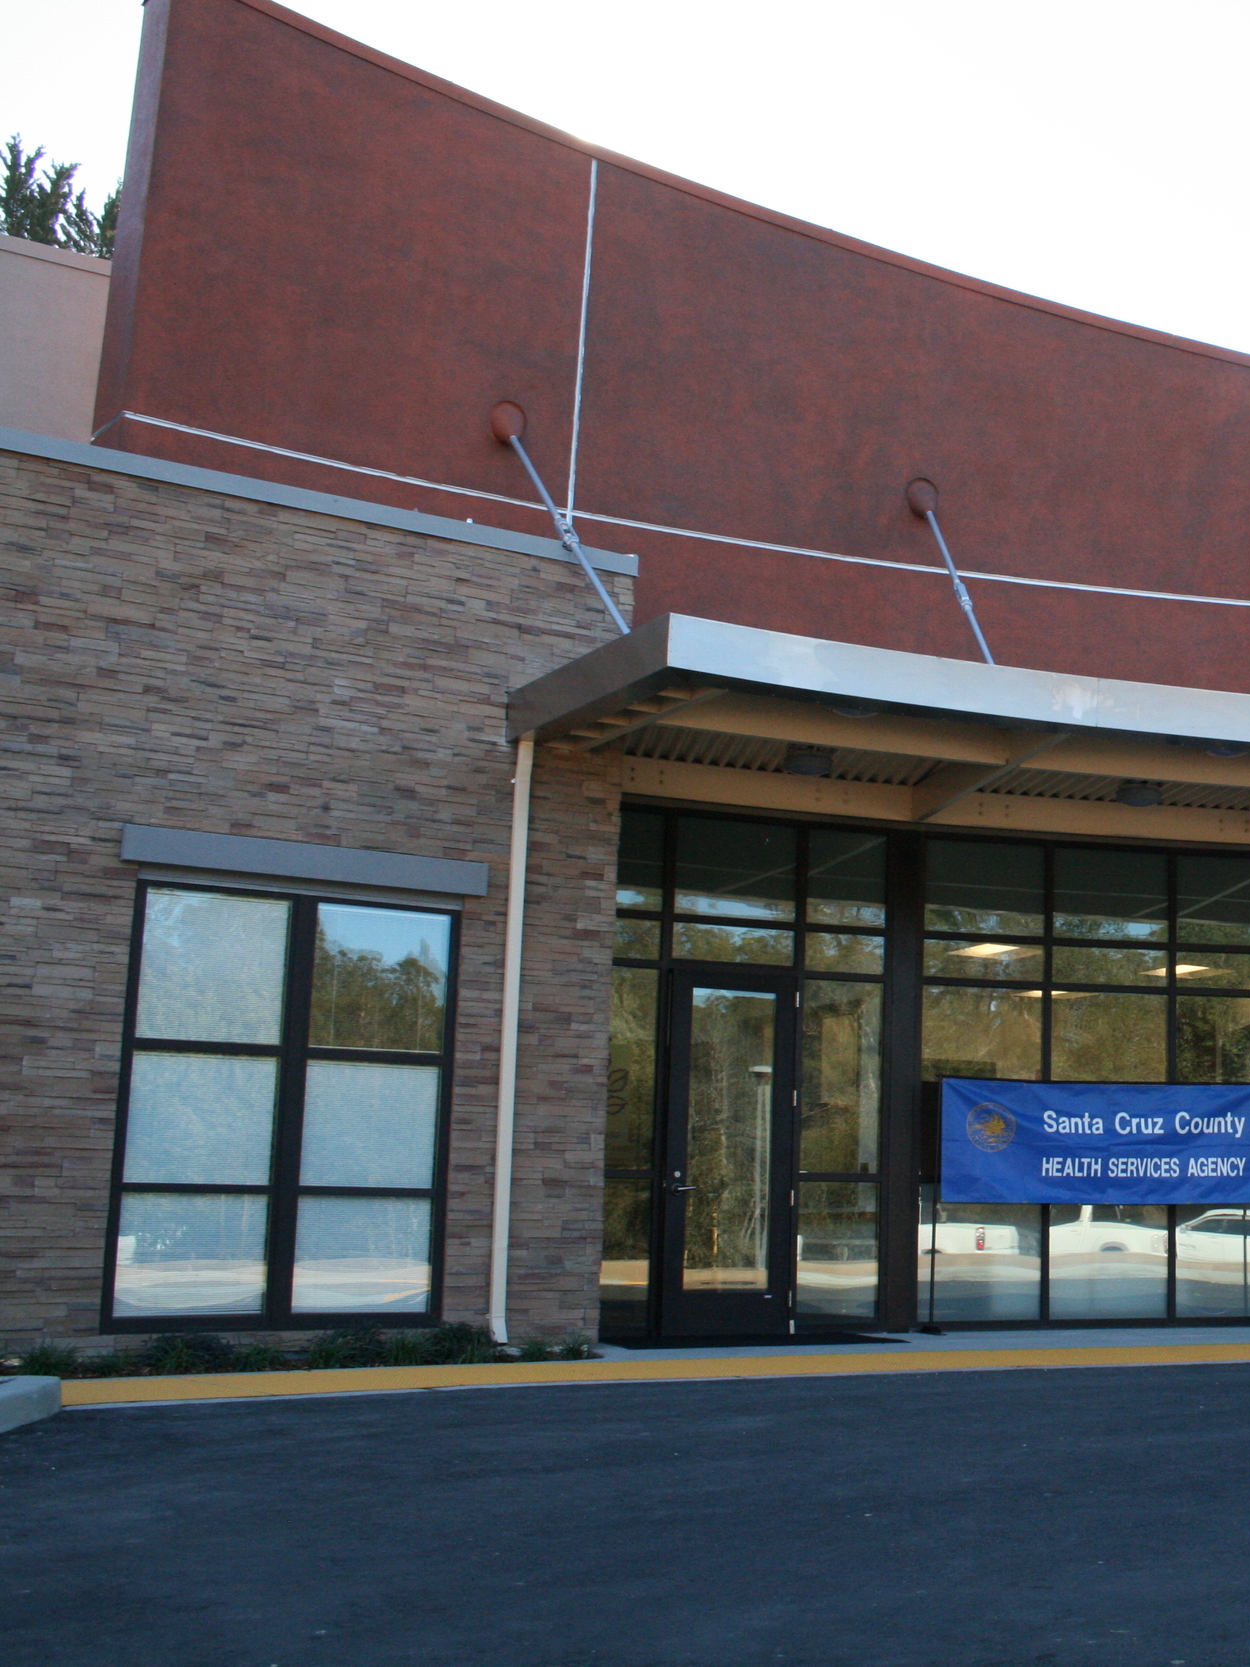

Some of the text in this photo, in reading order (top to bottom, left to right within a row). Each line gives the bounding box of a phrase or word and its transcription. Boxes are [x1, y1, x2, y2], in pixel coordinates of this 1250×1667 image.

[1043, 1110, 1104, 1135] Santa
[1114, 1112, 1165, 1135] Cruz
[1174, 1111, 1246, 1138] County
[1041, 1157, 1246, 1178] HEALTH SERVICES AGENCY
